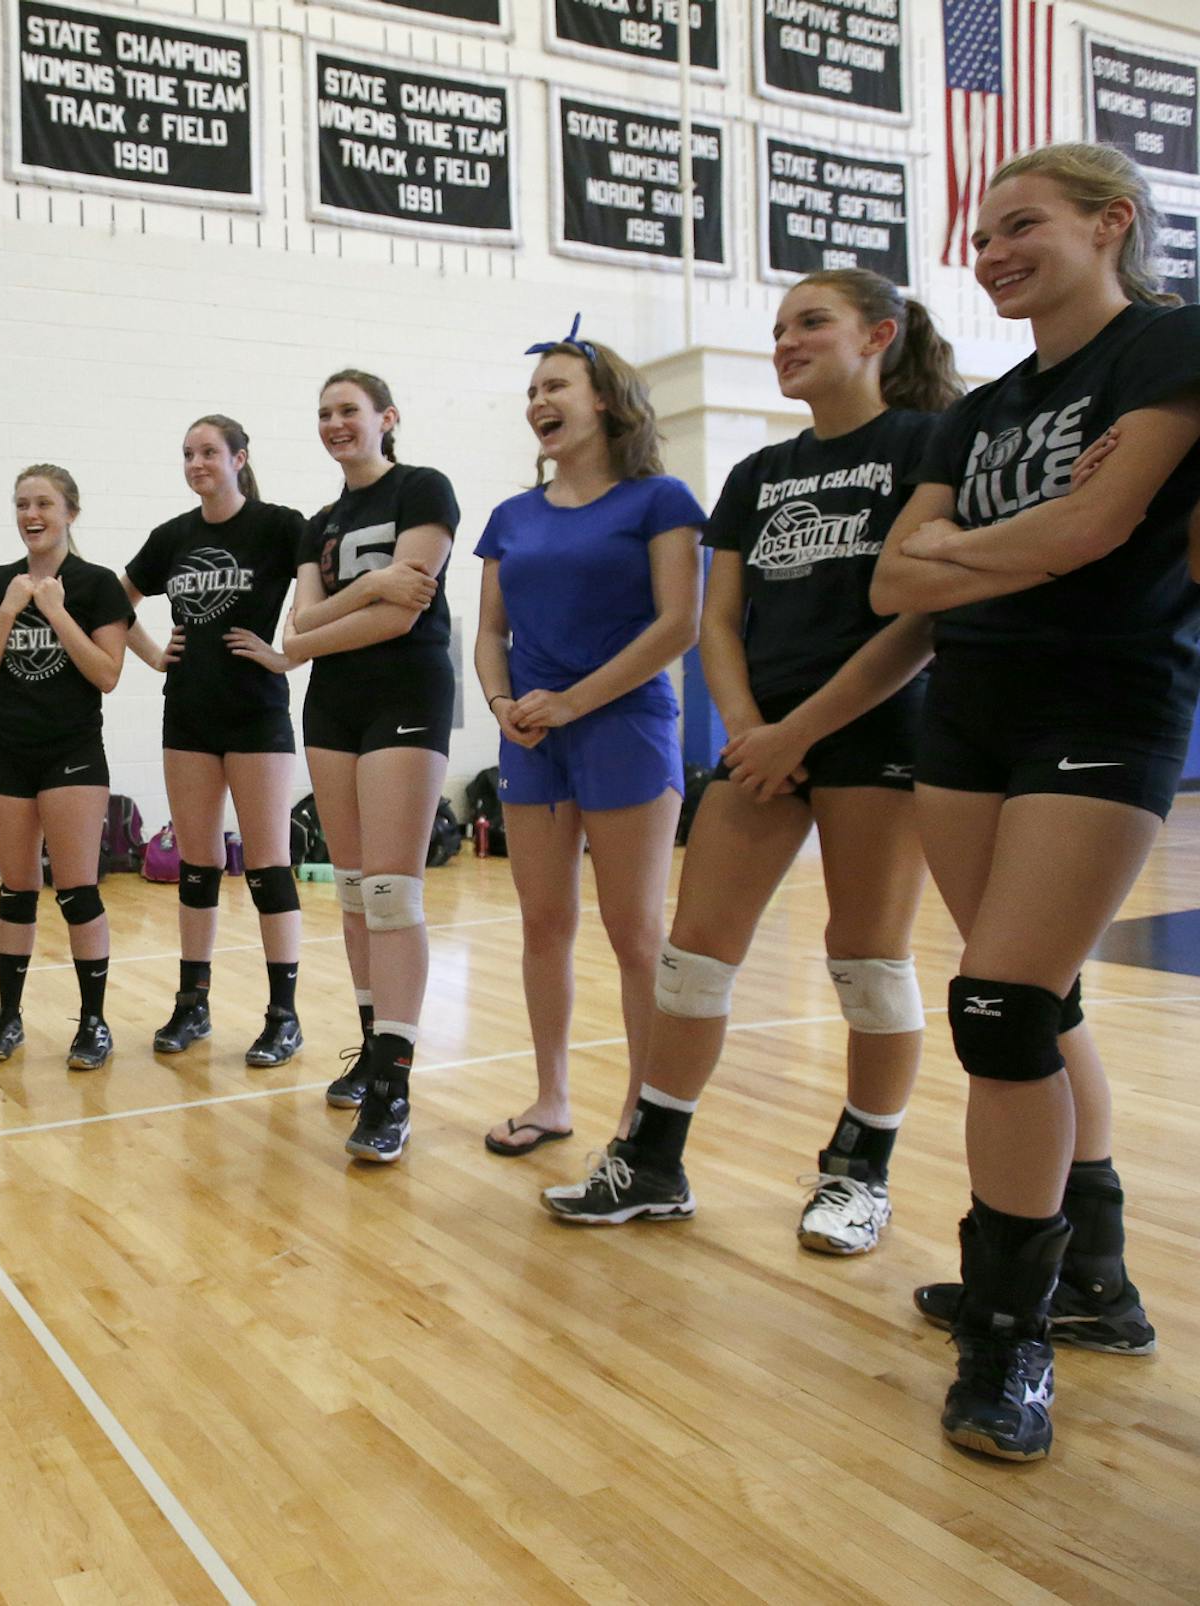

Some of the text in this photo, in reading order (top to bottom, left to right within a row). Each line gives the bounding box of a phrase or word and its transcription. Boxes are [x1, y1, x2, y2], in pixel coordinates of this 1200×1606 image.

[619, 18, 663, 50] 1992
[652, 0, 702, 29] FIED
[846, 14, 899, 46] SOCCER
[26, 15, 242, 78] STATE CHAMPIONS
[779, 24, 885, 73] GOLD DIVISION
[21, 51, 115, 95] WOMENS
[1134, 67, 1196, 98] CHAMPIONS
[324, 66, 502, 125] STATE CHAMPIONS
[1150, 101, 1194, 127] HOCKEY
[45, 94, 229, 147] TRACK & FIELD
[318, 98, 397, 141] WOMENS
[566, 110, 720, 160] STATE CHAMPONS
[113, 140, 169, 175] 1990
[338, 138, 491, 188] TRACK & FIELD
[608, 150, 680, 187] WOMENS
[771, 150, 903, 196] STATE CHAMPIONS
[398, 183, 444, 215] 1991
[586, 177, 705, 220] NORDIC SKIIG
[770, 179, 907, 225] ADAPTIVE SOFTBALL
[626, 217, 666, 247] 1995
[786, 212, 891, 253] GOLD DIVISION
[757, 462, 894, 510] ECTION CHAMPS
